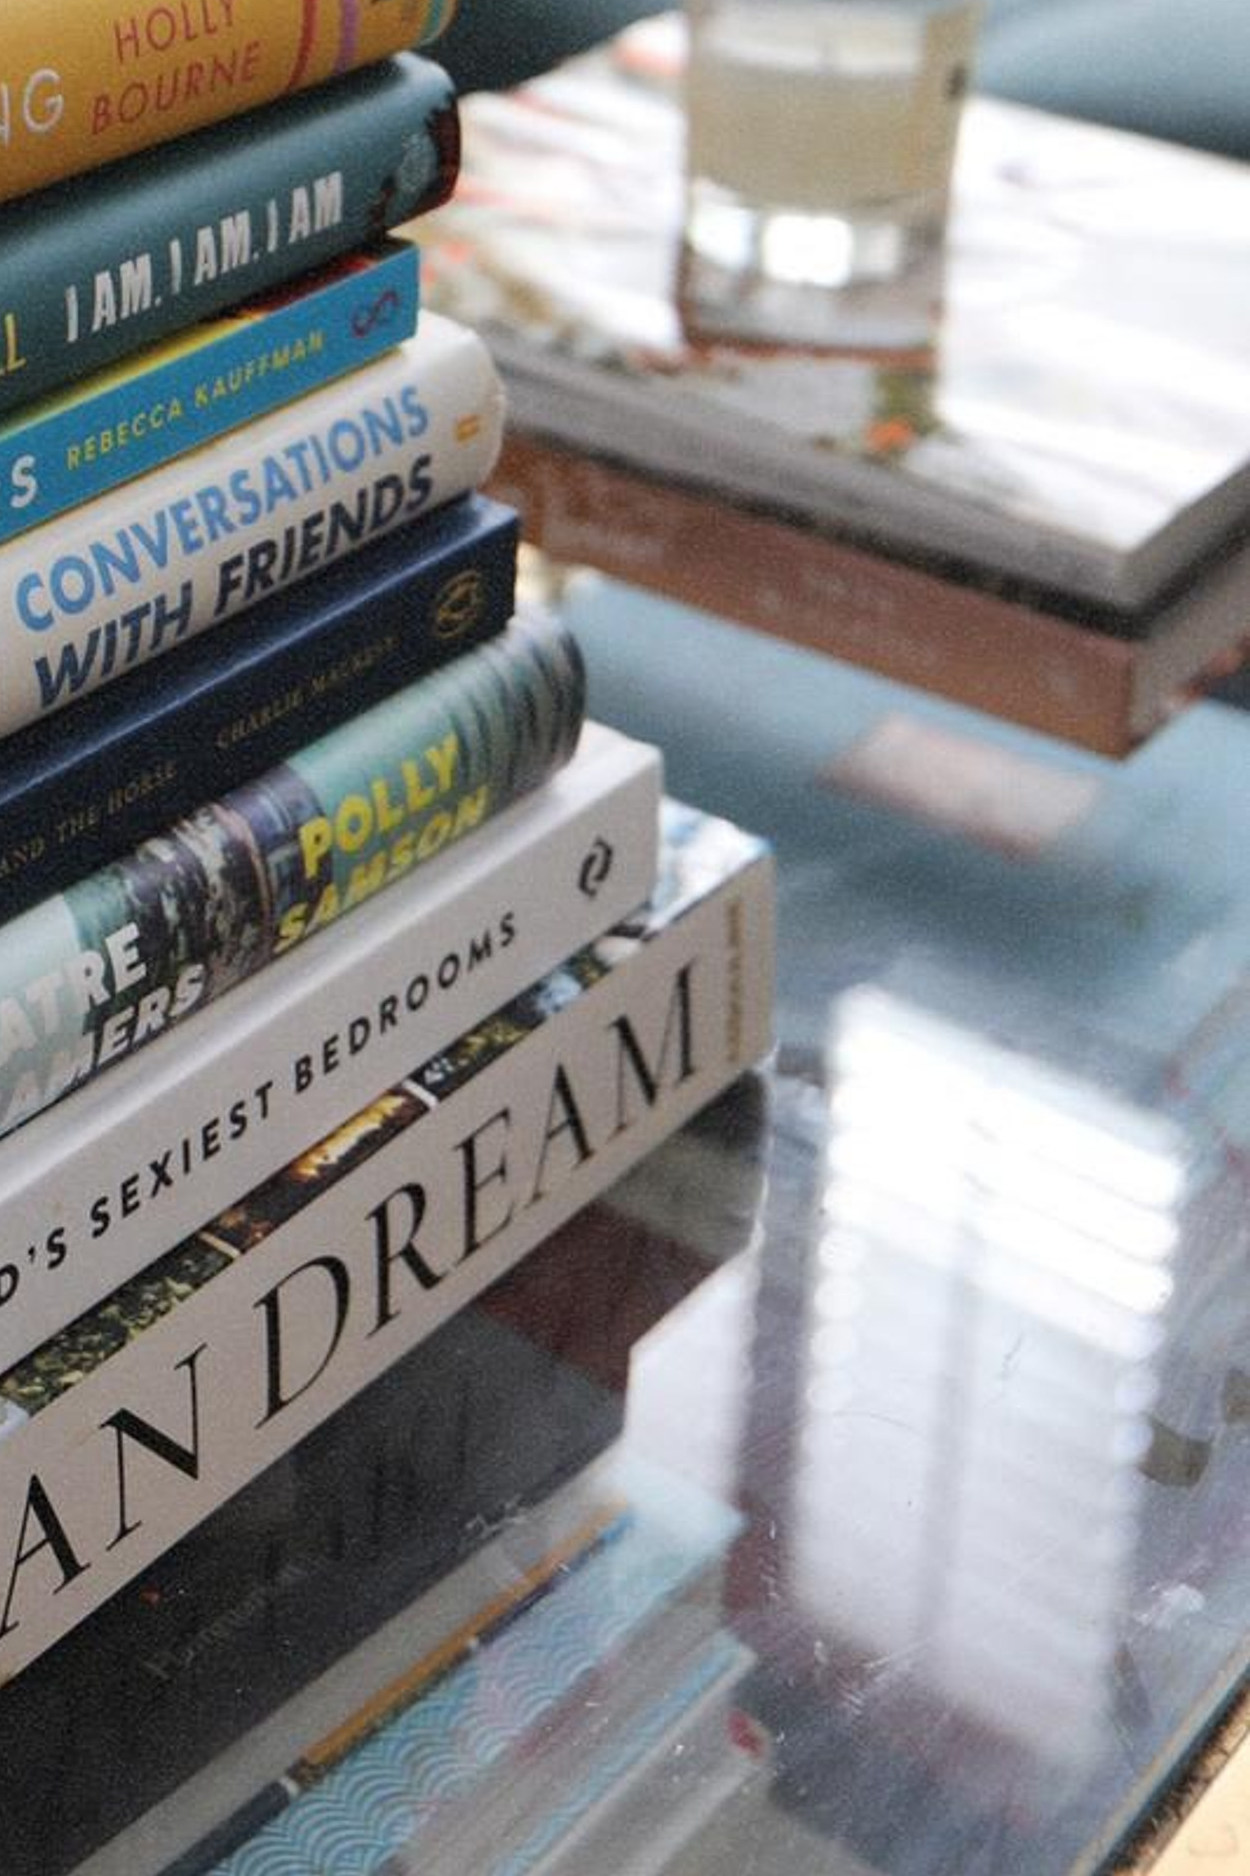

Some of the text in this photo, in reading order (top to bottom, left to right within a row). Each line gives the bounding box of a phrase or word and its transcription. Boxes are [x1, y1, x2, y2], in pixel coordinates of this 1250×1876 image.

[91, 41, 263, 136] BOURNE
[65, 284, 80, 344] I
[169, 237, 183, 296] I
[266, 198, 279, 254] I
[287, 170, 343, 245] AM
[66, 331, 326, 472] REBECCA KAUFFMAN
[14, 385, 430, 632] CONVERSATIONS
[34, 453, 433, 710] WITH FRIENDS
[56, 806, 98, 843] THE
[274, 787, 488, 954] SAMSON
[299, 731, 459, 879] POLLY
[89, 1081, 273, 1238] SEXIEST
[293, 913, 517, 1093] BEDROOMS
[255, 956, 698, 1430] DREAM
